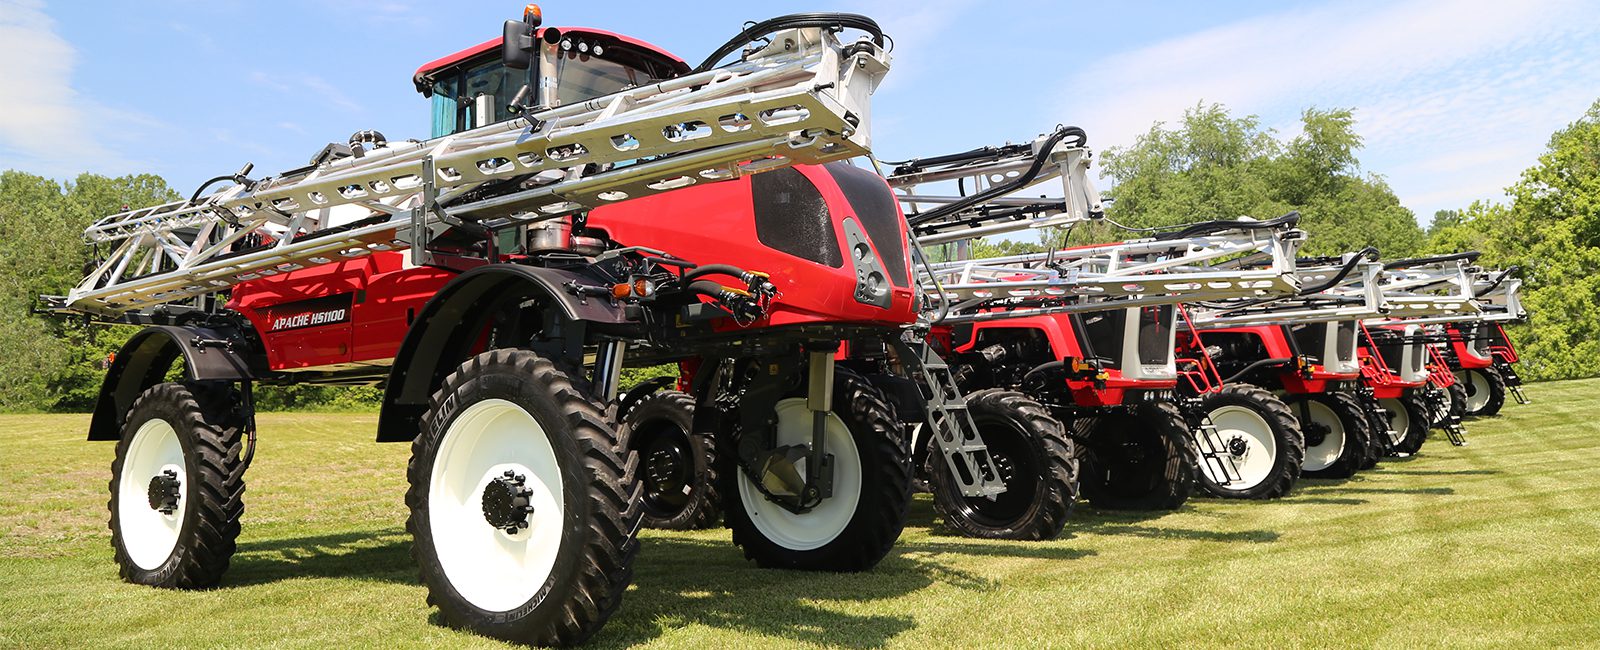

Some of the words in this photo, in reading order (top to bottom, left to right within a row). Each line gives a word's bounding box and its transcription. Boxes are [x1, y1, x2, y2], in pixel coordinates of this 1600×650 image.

[272, 314, 310, 331] APACHE
[311, 309, 345, 325] HS1100
[507, 587, 547, 621] MICHELIN
